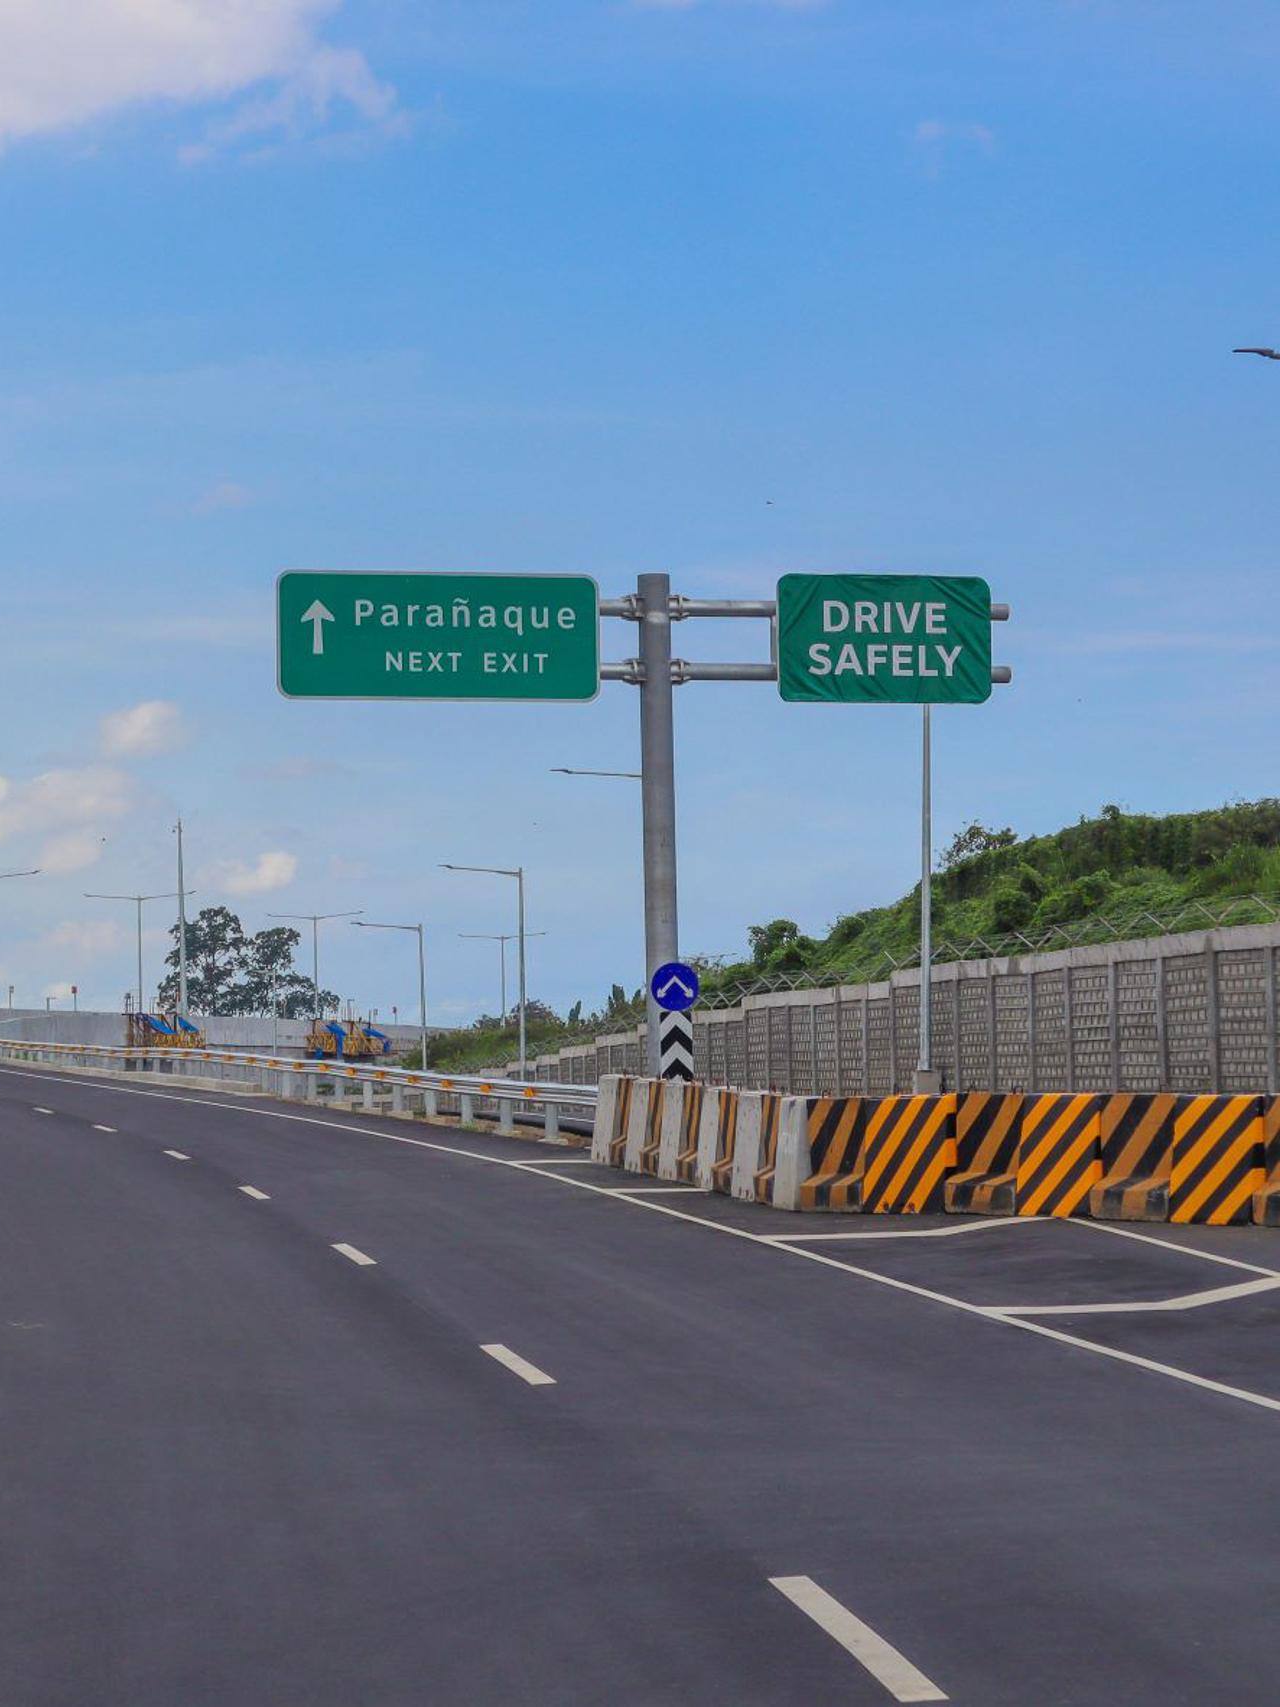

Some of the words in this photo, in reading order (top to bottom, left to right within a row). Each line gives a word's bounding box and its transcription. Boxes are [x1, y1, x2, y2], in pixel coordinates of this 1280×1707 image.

[355, 597, 577, 635] Parañaque
[822, 600, 948, 634] DRIVE
[384, 651, 462, 673] NEXT
[484, 652, 549, 674] EXIT
[808, 643, 963, 677] SAFELY
